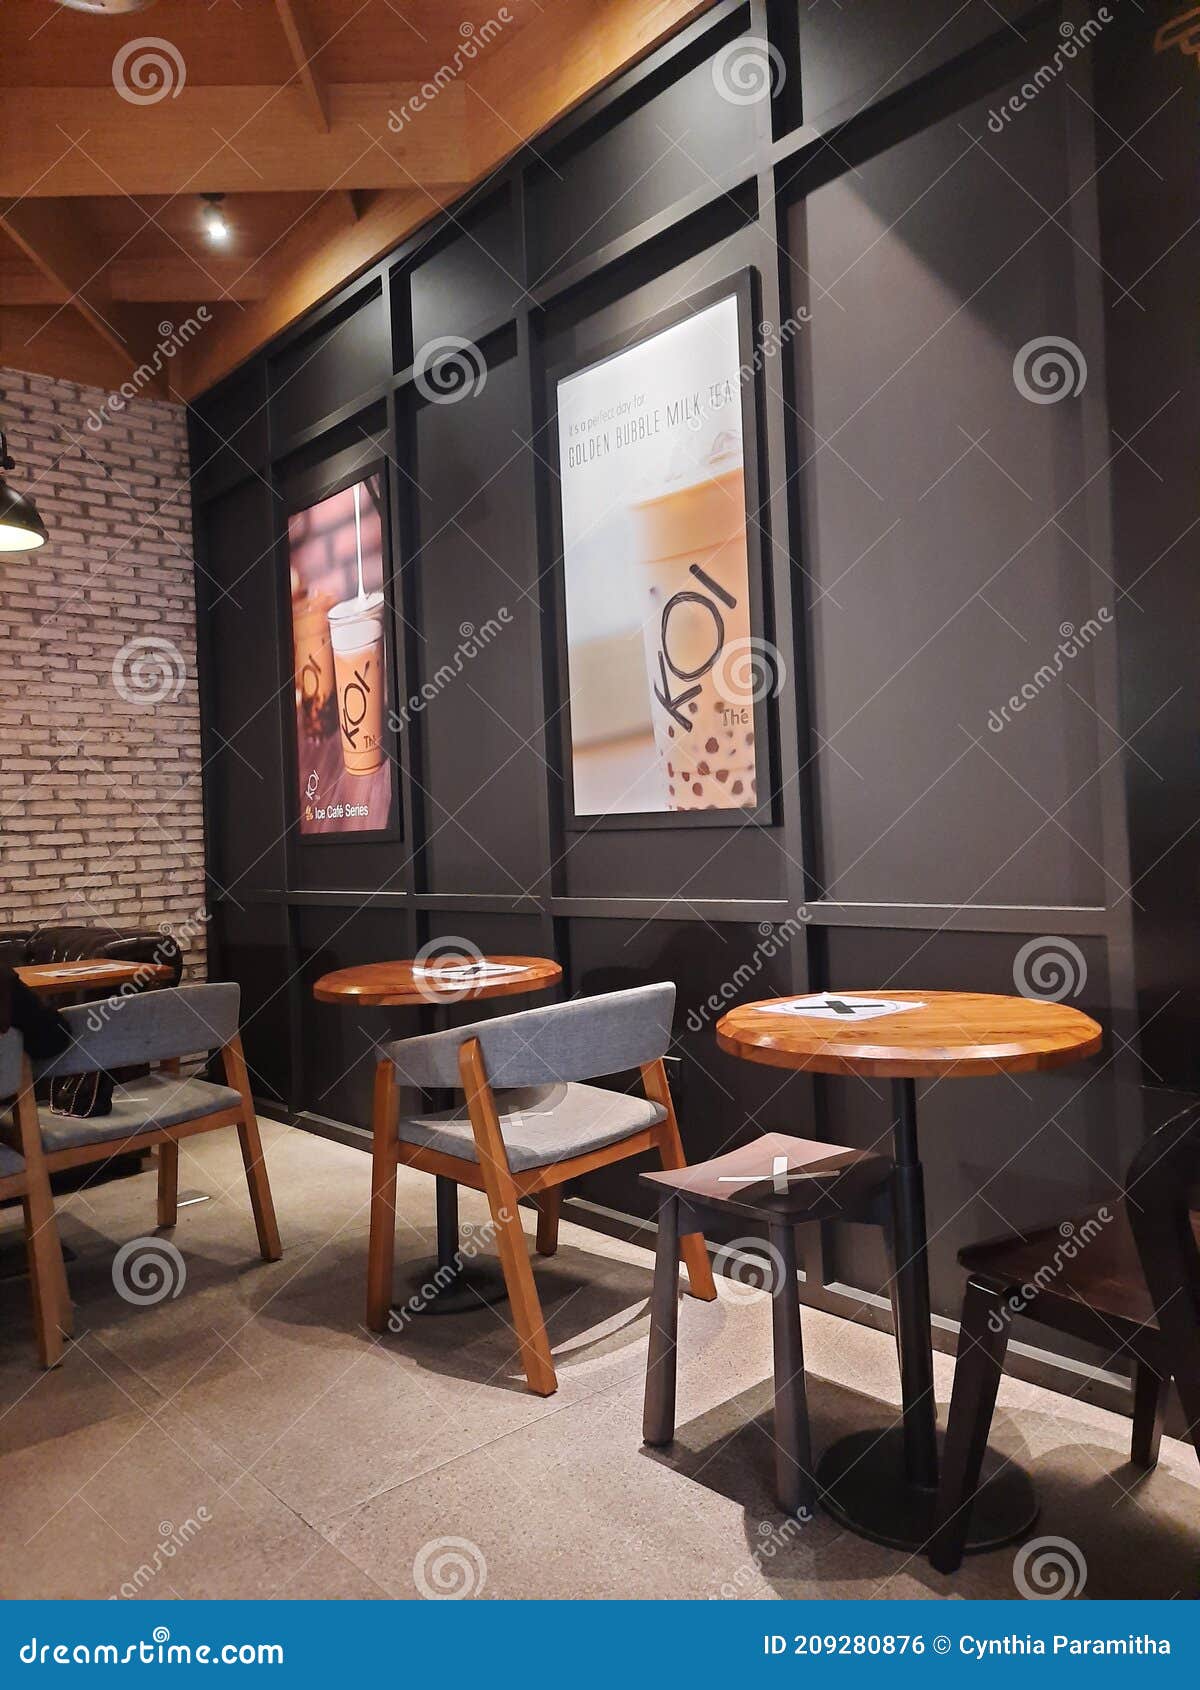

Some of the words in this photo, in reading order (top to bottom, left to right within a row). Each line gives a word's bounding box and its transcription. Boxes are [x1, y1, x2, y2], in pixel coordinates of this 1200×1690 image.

[569, 431, 610, 468] GOLDEN
[616, 410, 660, 449] BUBBLE
[667, 392, 701, 428] MILK
[709, 380, 732, 407] TEA
[616, 401, 631, 416] day
[654, 564, 737, 733] KOI
[342, 670, 370, 749] KOI
[722, 708, 749, 726] Thé
[315, 807, 326, 820] Ice
[326, 804, 344, 819] Café
[345, 803, 369, 817] Series
